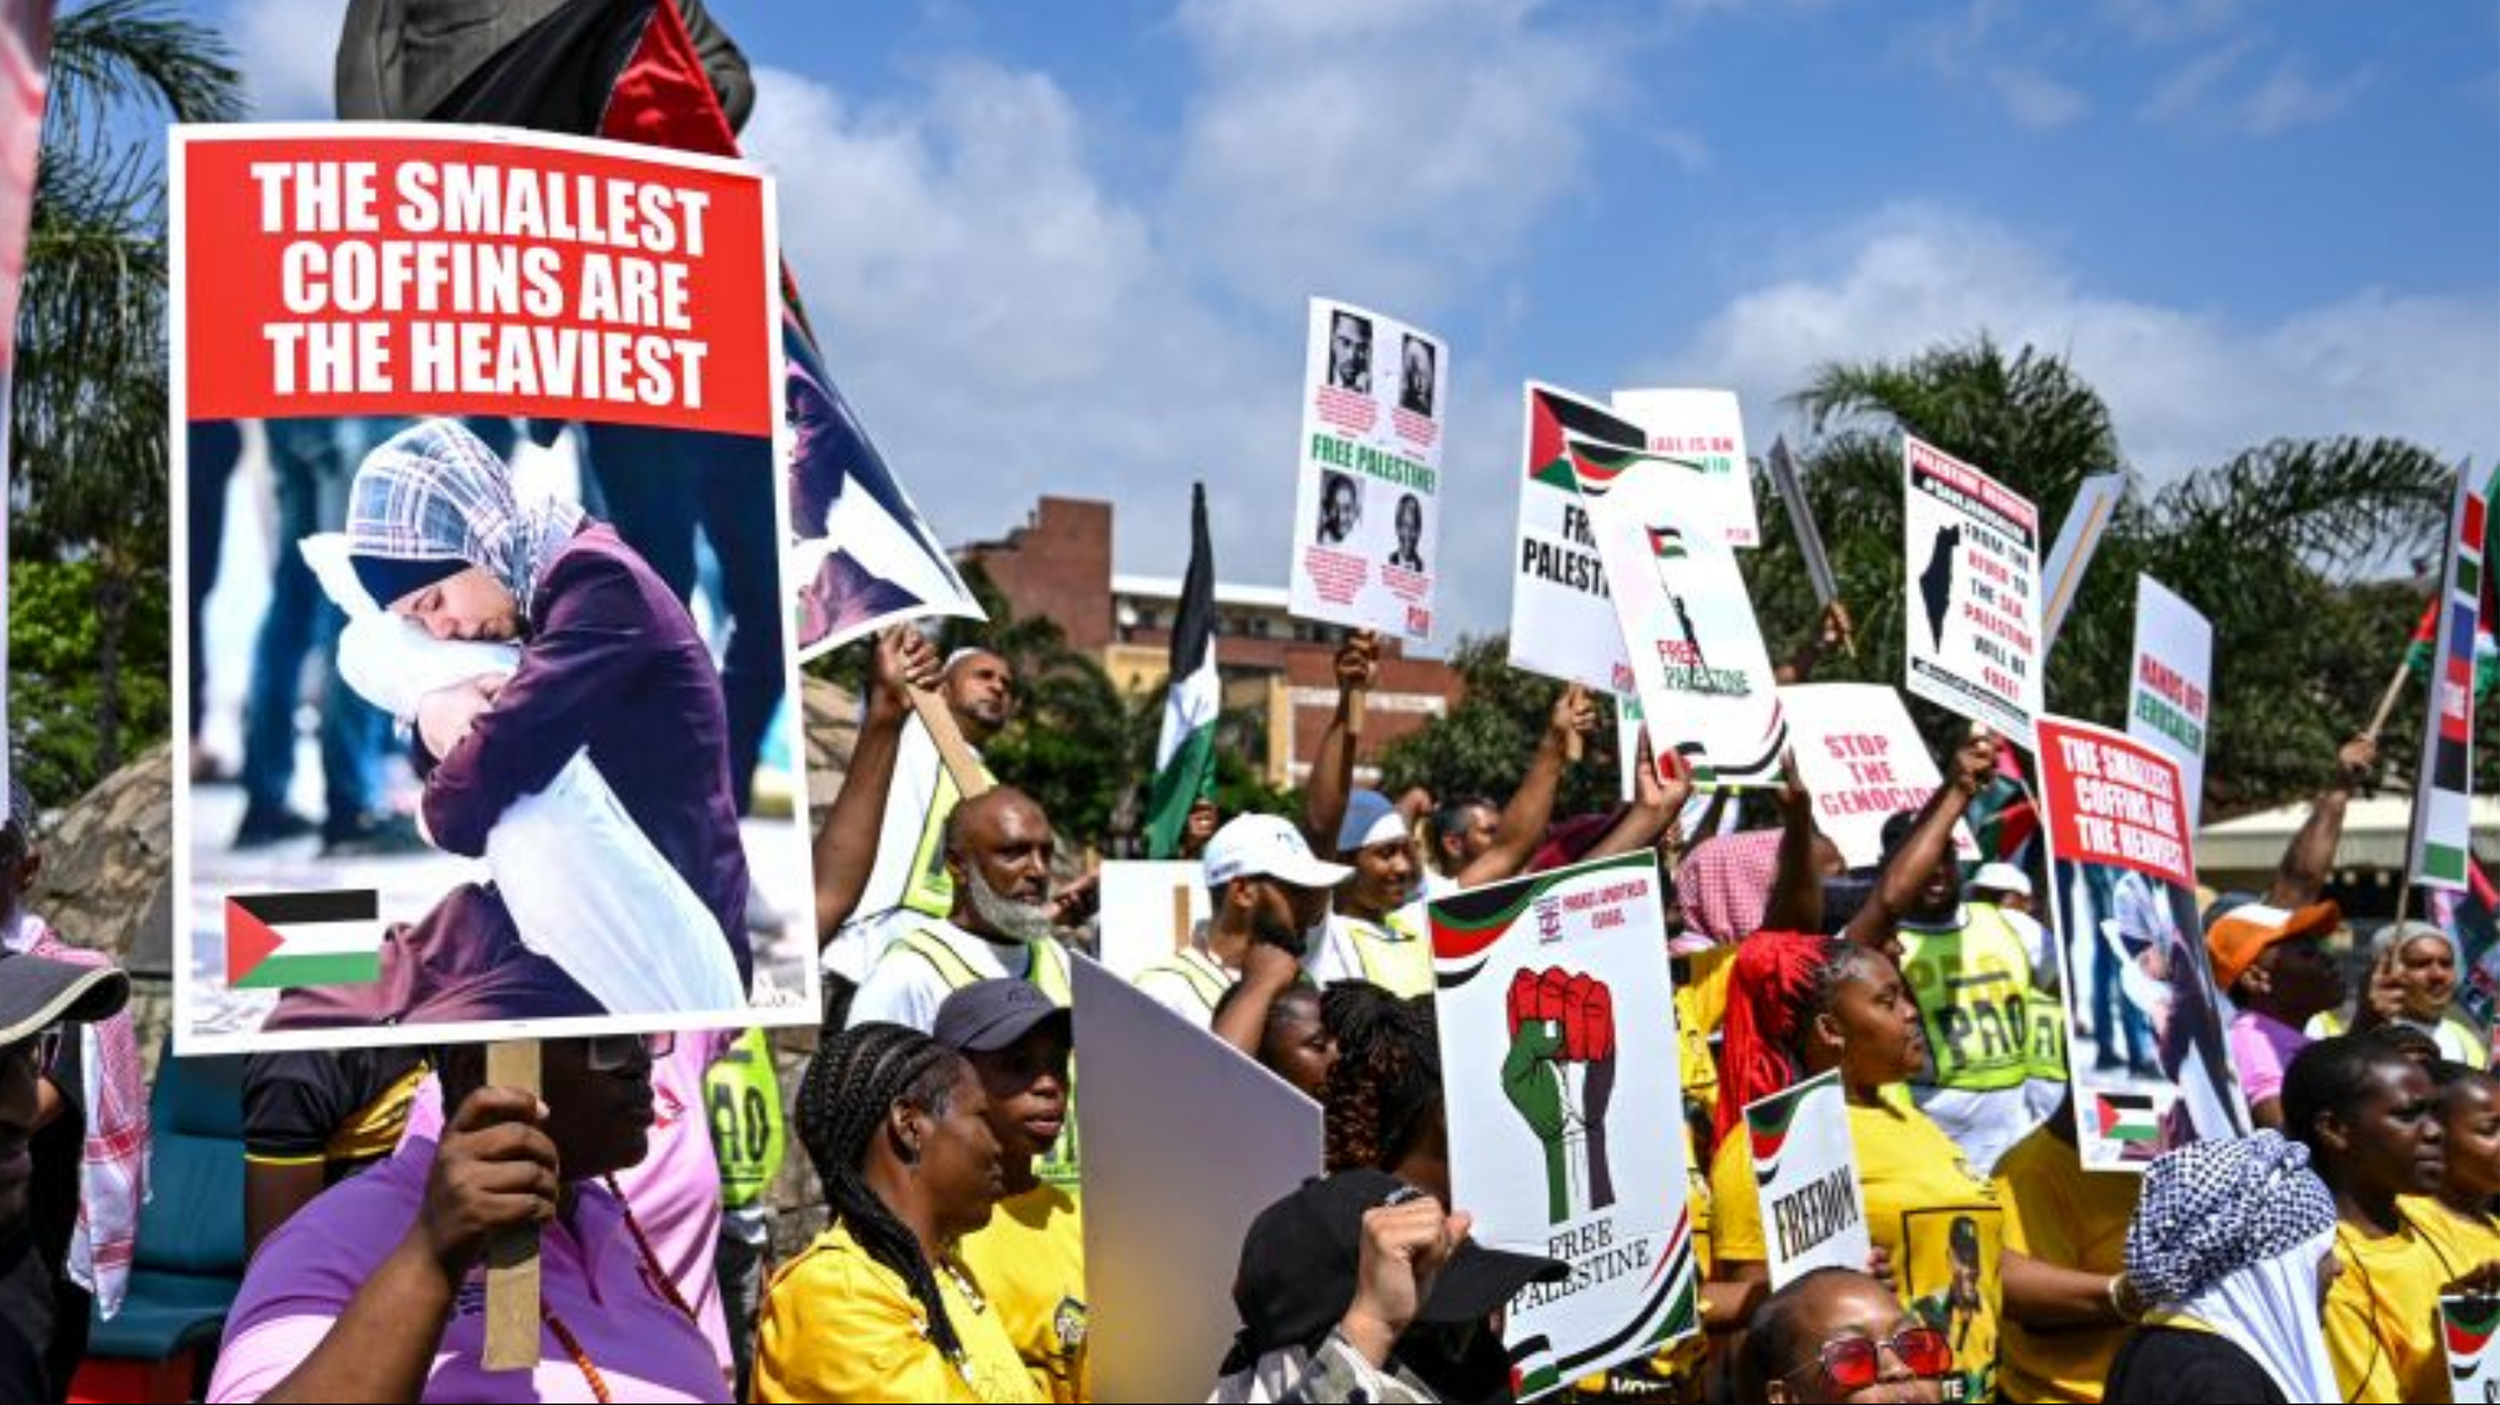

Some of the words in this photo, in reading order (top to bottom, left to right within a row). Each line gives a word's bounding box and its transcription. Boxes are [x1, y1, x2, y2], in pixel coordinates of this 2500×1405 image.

[251, 161, 378, 232] THE
[396, 161, 710, 257] SMALLEST
[281, 241, 563, 318] COFFINS
[579, 254, 692, 331] ARE
[263, 321, 392, 395] THE
[411, 323, 707, 409] HEAVIEST
[1311, 433, 1353, 469] FREE
[1562, 503, 1597, 549] FR
[1522, 536, 1610, 599] PALEST
[1971, 577, 1994, 605] THE
[1963, 601, 2033, 656] PALESTINE
[1824, 734, 1889, 758] STOP
[2057, 735, 2099, 775] THE
[1847, 761, 1897, 784] THE
[2074, 813, 2121, 855] THE
[1772, 1163, 1858, 1263] FREEDOM
[1549, 1218, 1612, 1260] FREE
